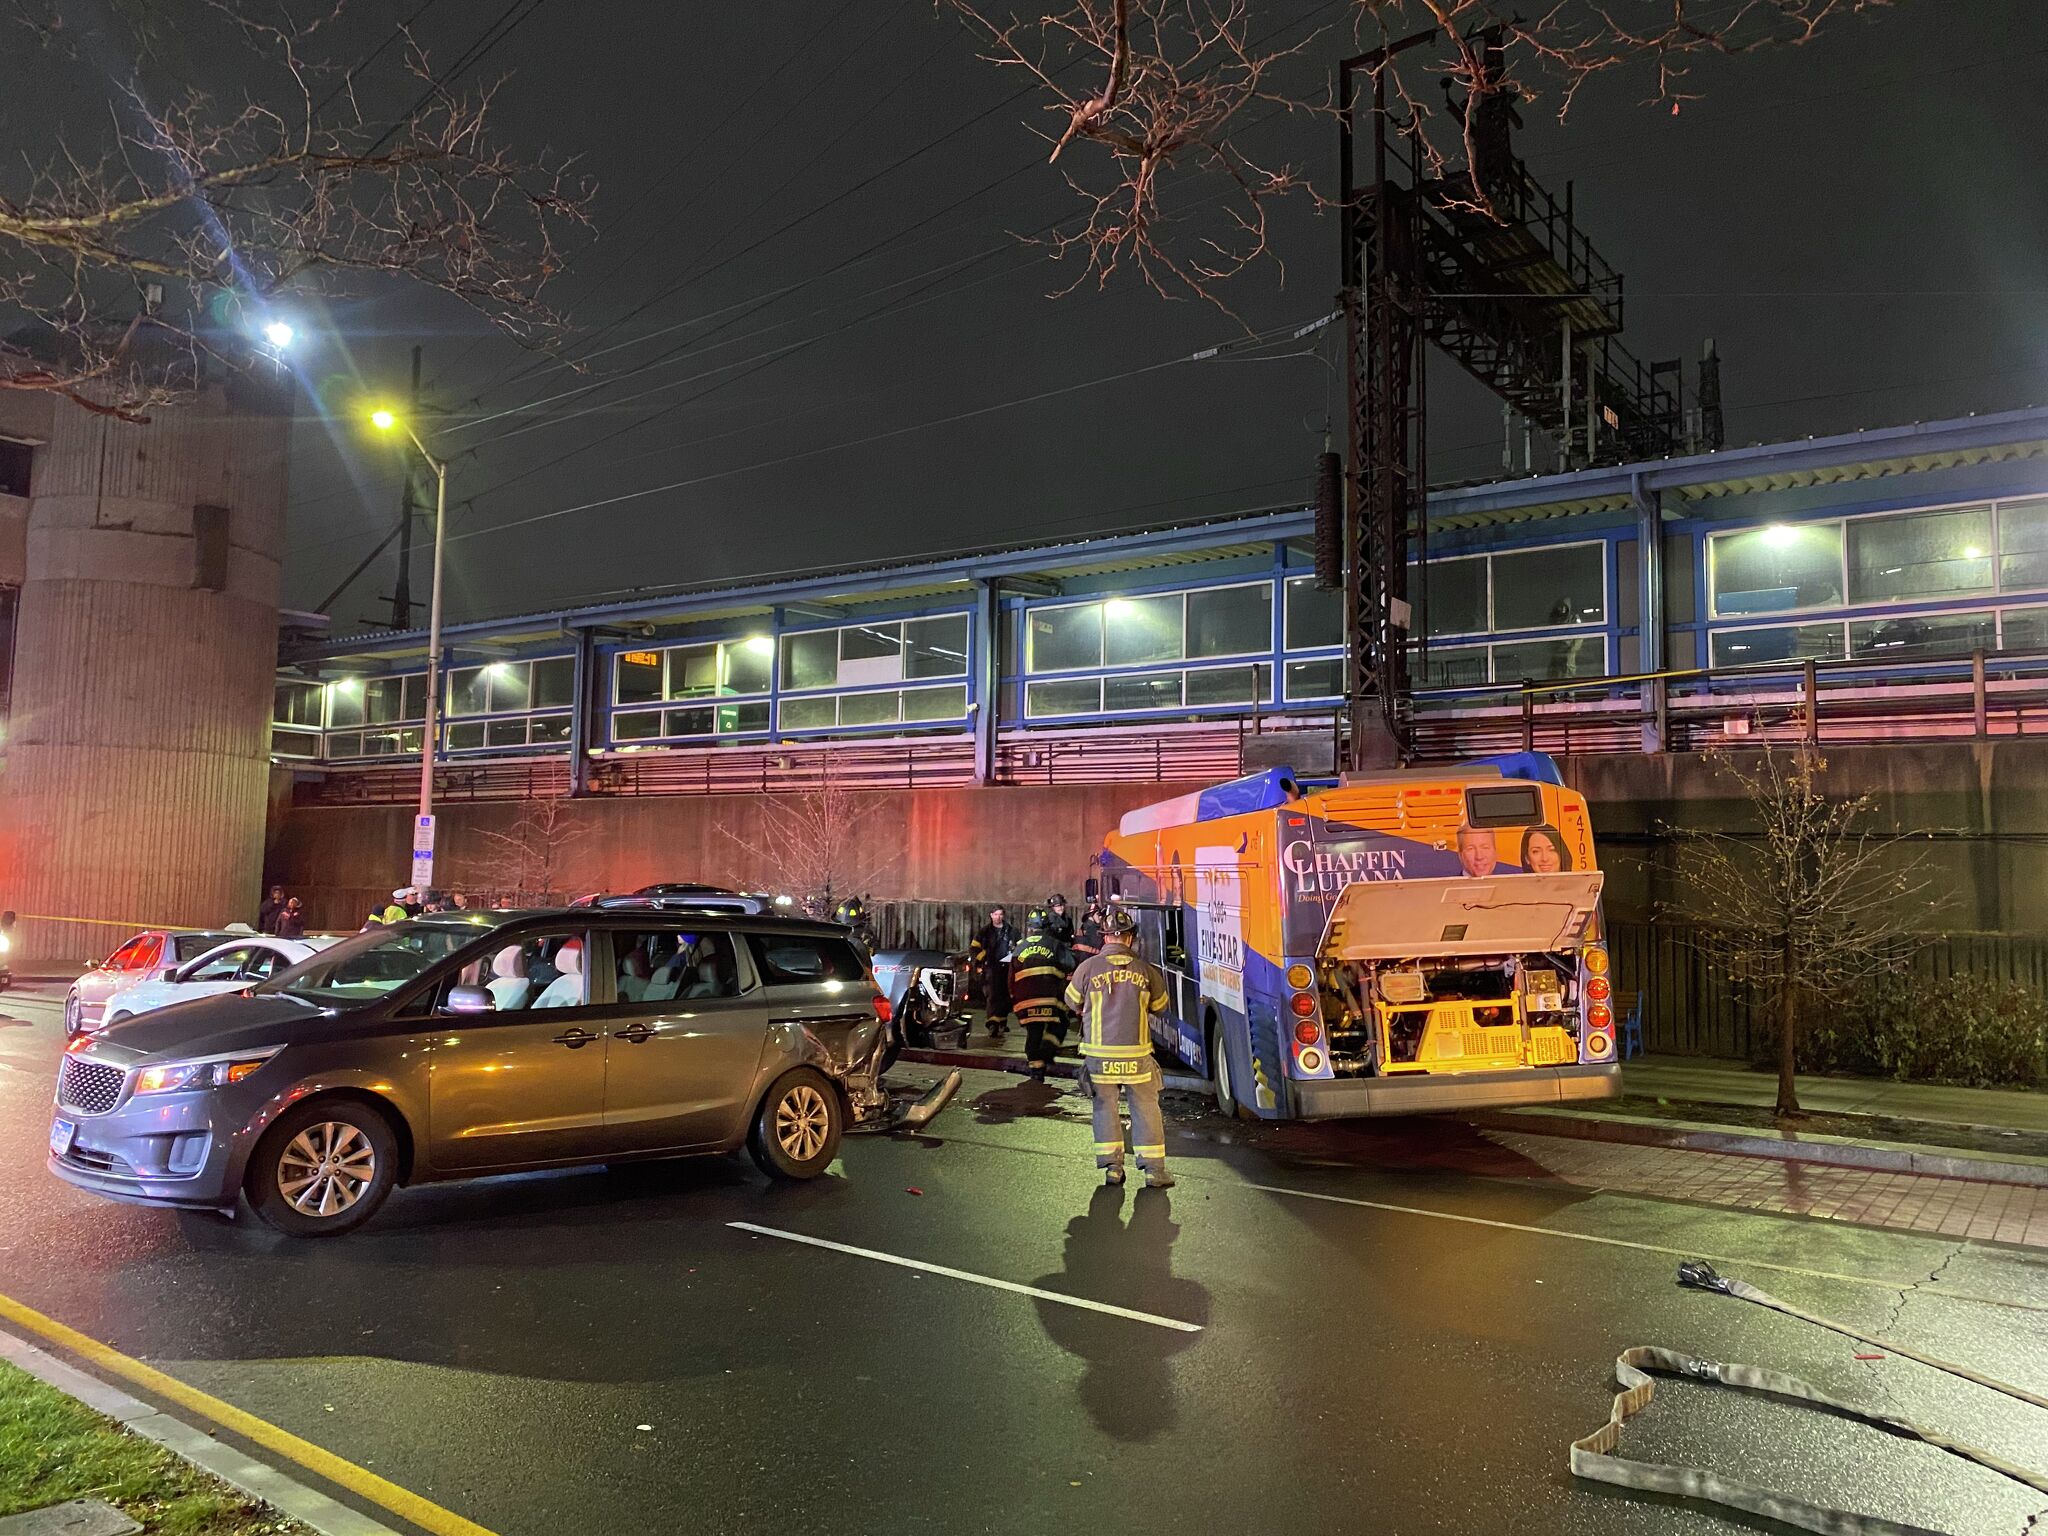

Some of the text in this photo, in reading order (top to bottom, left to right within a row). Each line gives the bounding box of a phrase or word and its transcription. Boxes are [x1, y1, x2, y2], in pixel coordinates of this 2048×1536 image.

[1284, 840, 1405, 873] CHAFFIN
[1577, 815, 1587, 869] 4705
[1298, 893, 1322, 903] Doing
[1201, 929, 1239, 966] FIVE-STAR
[1102, 1060, 1138, 1074] EASTUS
